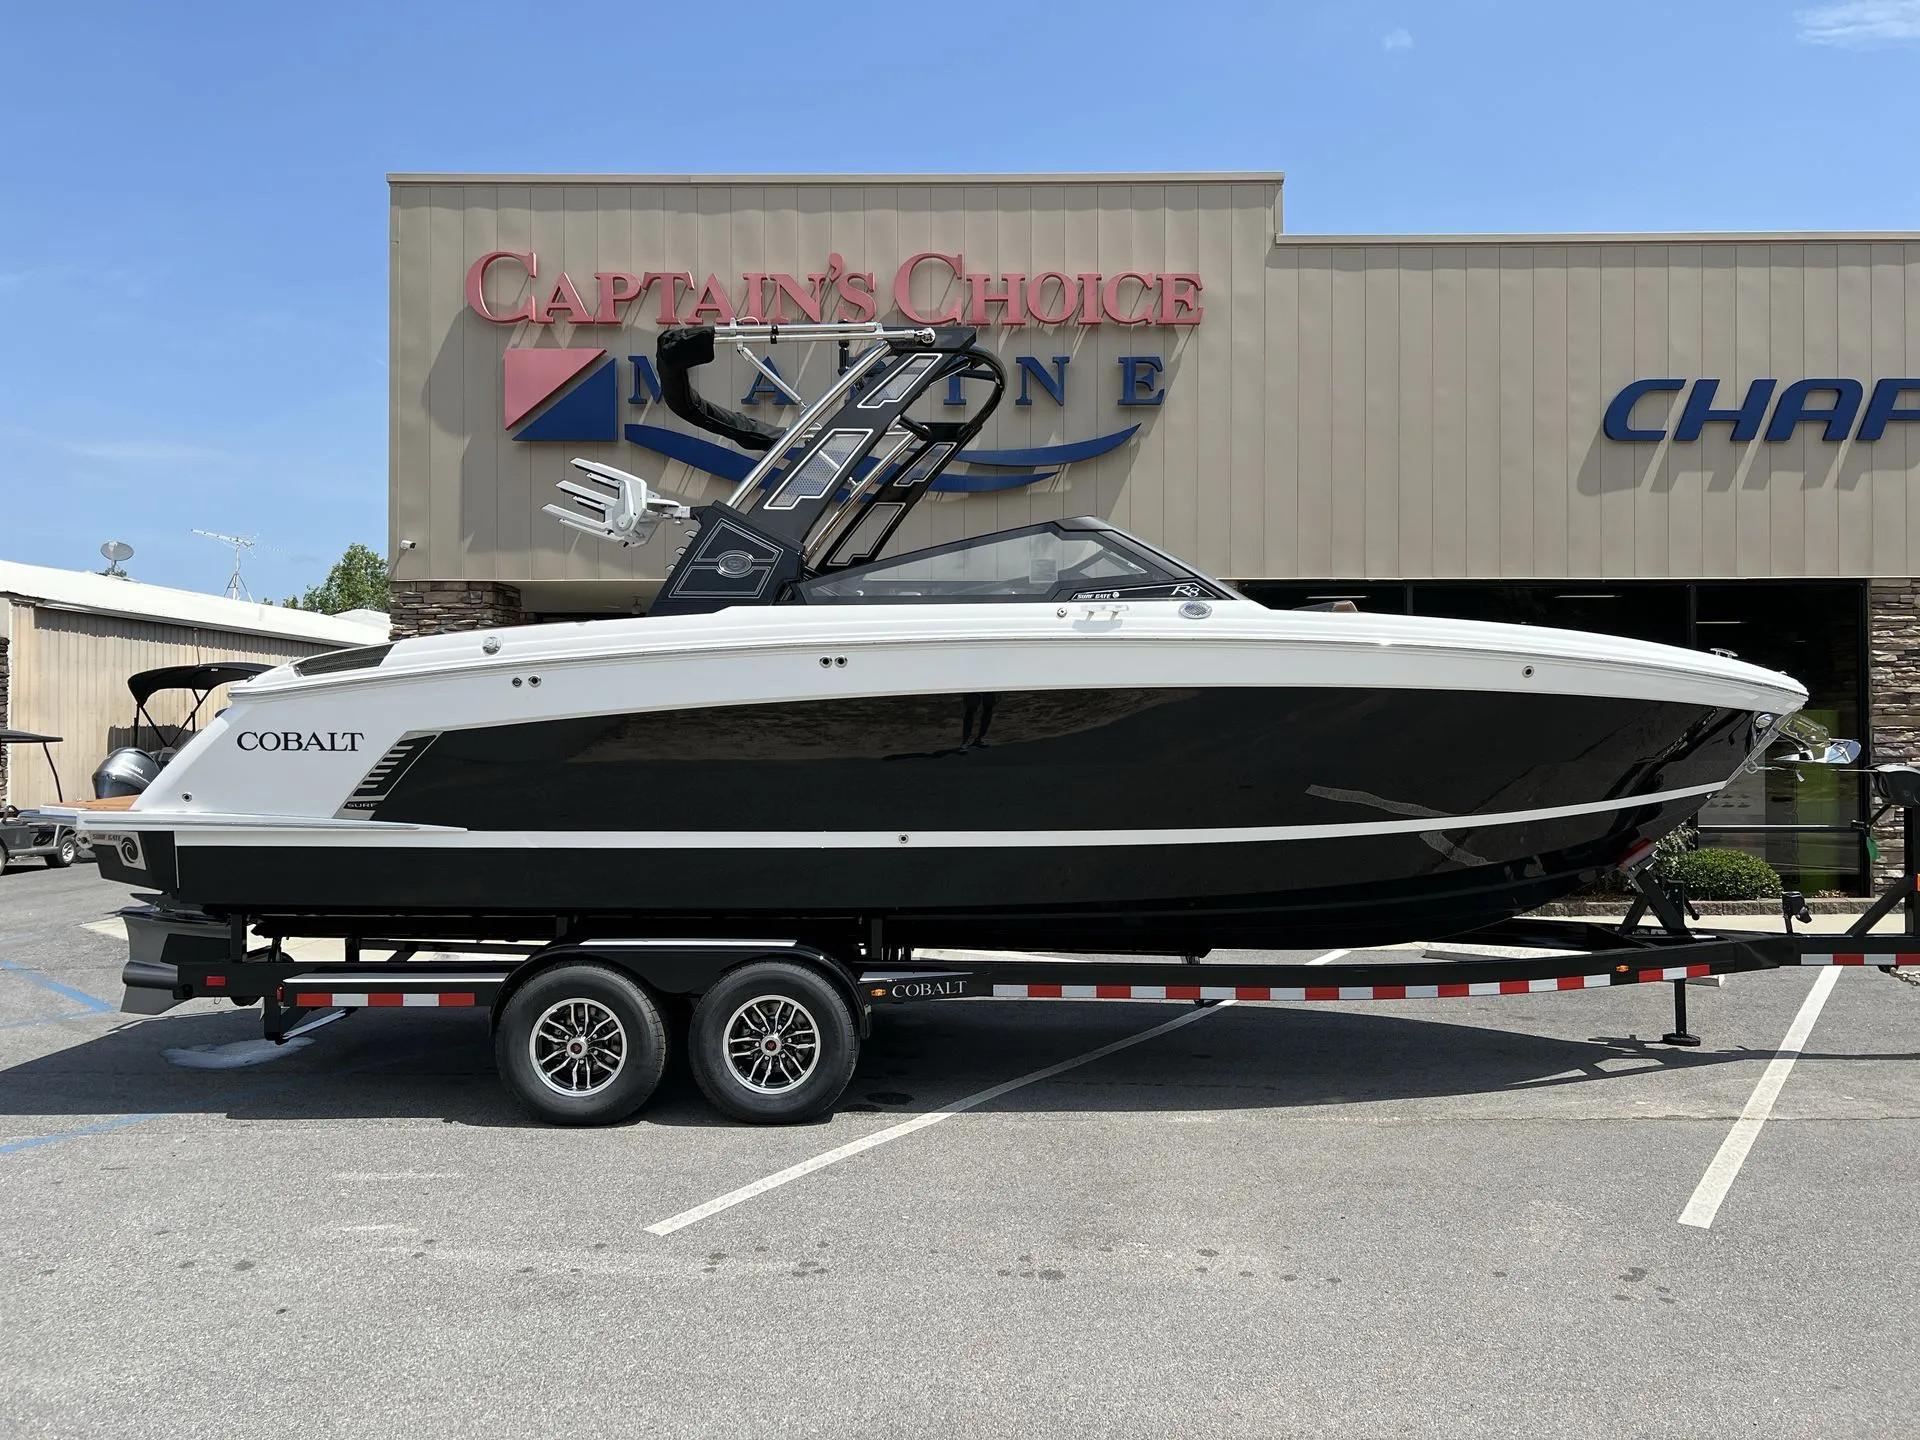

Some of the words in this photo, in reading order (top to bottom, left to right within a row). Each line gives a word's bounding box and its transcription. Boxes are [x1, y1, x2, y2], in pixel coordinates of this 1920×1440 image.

[465, 251, 876, 325] CAPTAIN'S
[893, 252, 1205, 326] CHOICE
[627, 355, 1166, 406] MAINE
[236, 731, 365, 752] COBALT
[892, 980, 968, 998] COBALT
